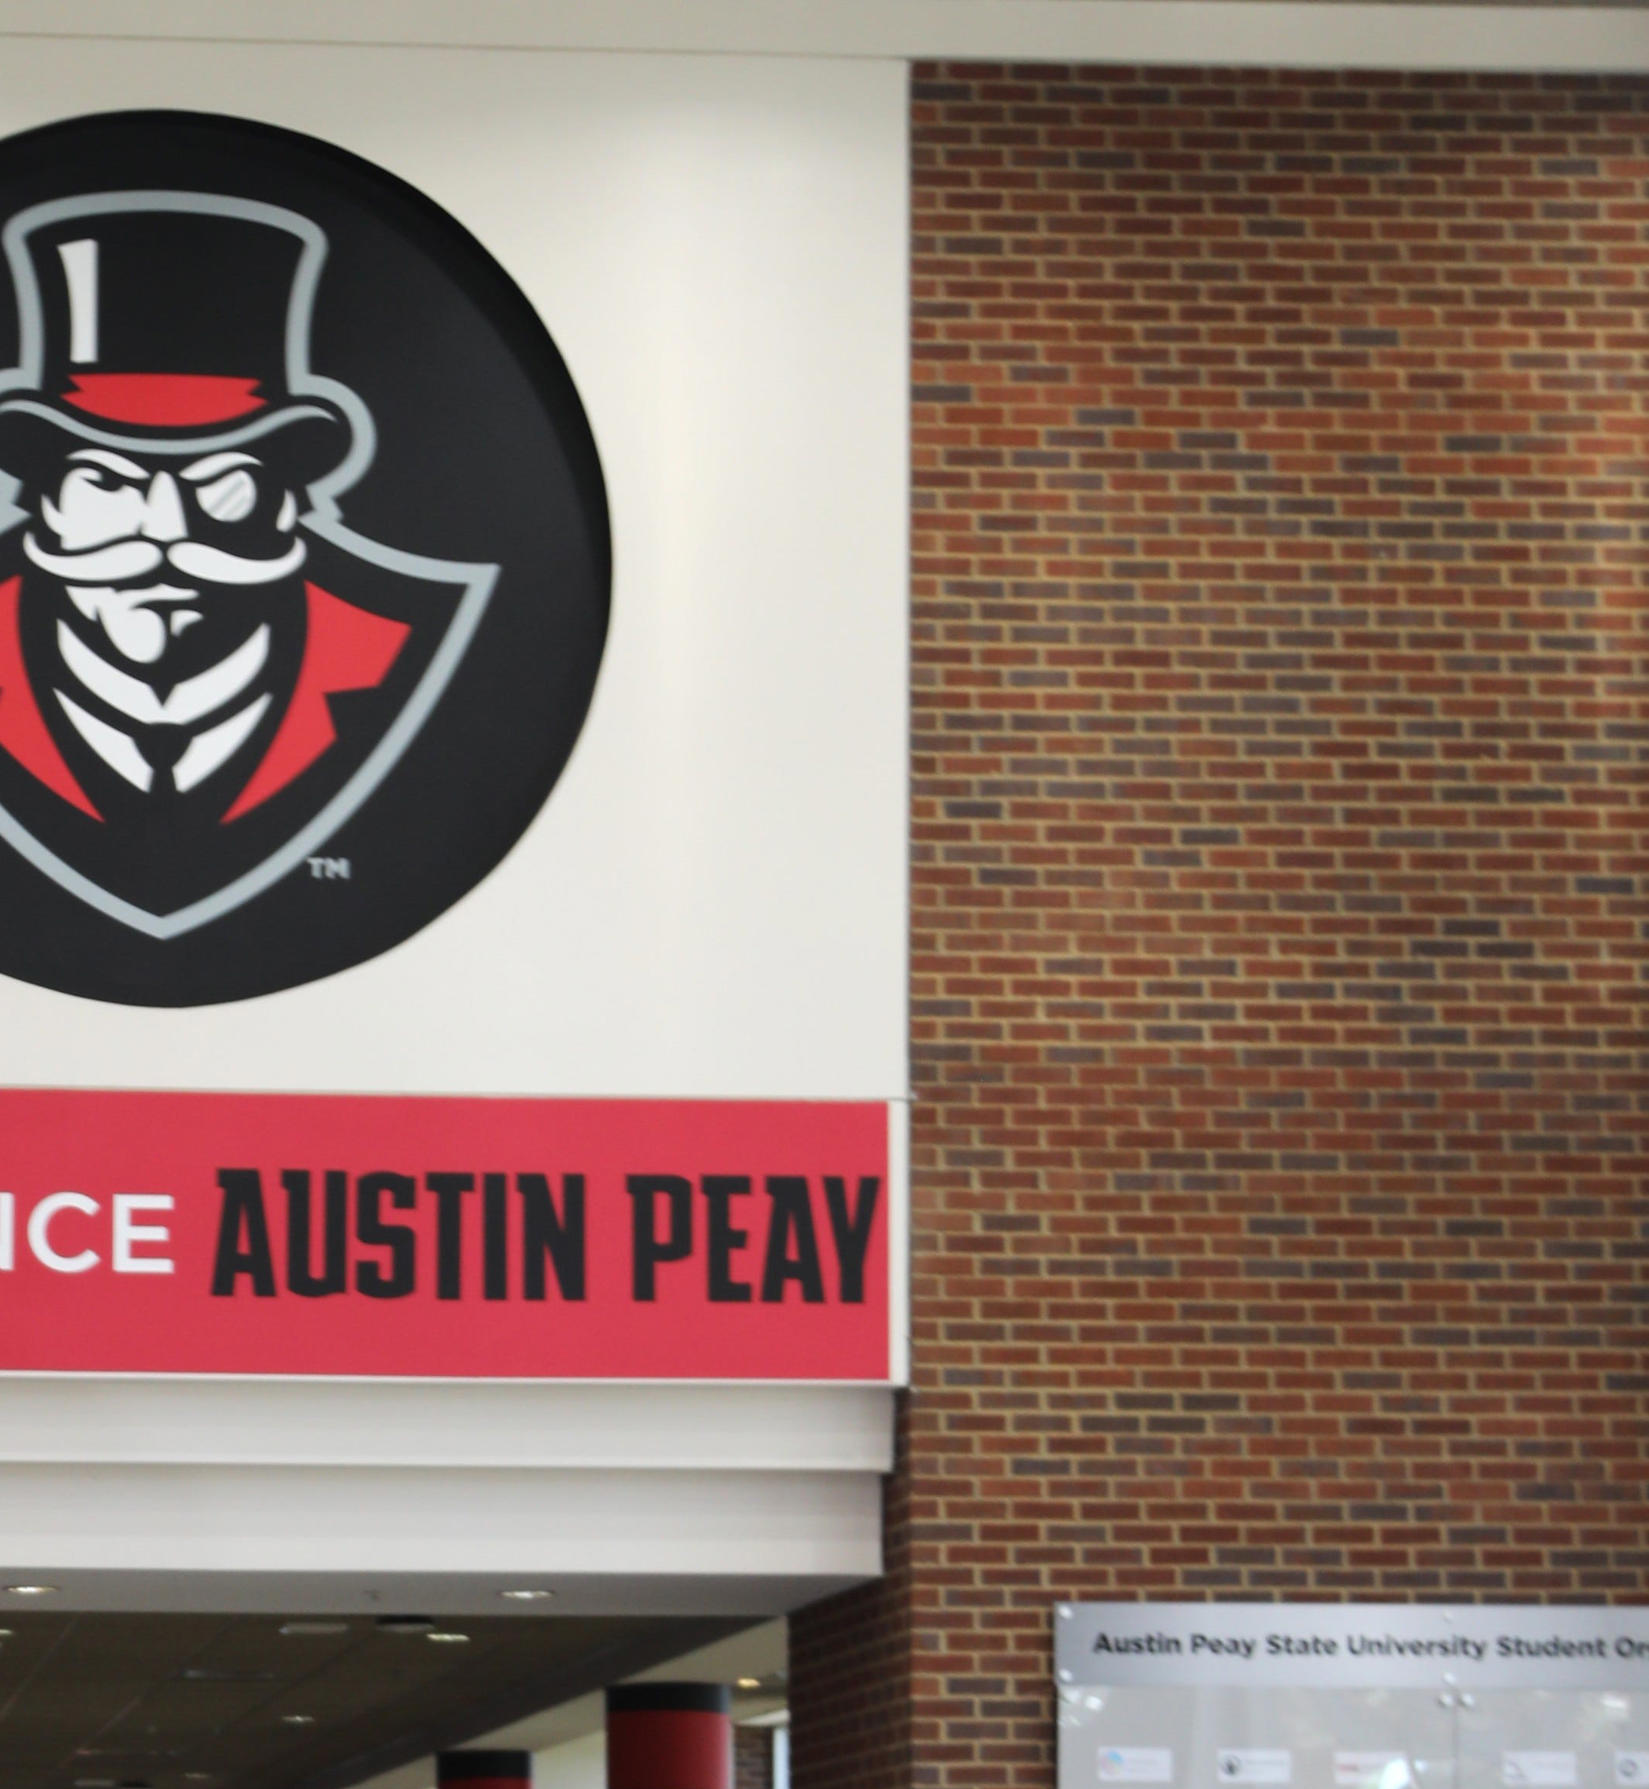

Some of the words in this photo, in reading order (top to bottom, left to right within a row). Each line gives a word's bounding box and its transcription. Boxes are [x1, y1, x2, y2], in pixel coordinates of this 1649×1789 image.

[307, 857, 350, 879] TM
[210, 1168, 586, 1302] AUSTIN
[625, 1173, 880, 1304] PEAY
[1094, 1631, 1182, 1655] Austin
[1190, 1632, 1256, 1661] Peay
[1265, 1634, 1339, 1656] State
[1346, 1634, 1487, 1660] University
[1496, 1636, 1608, 1658] Student
